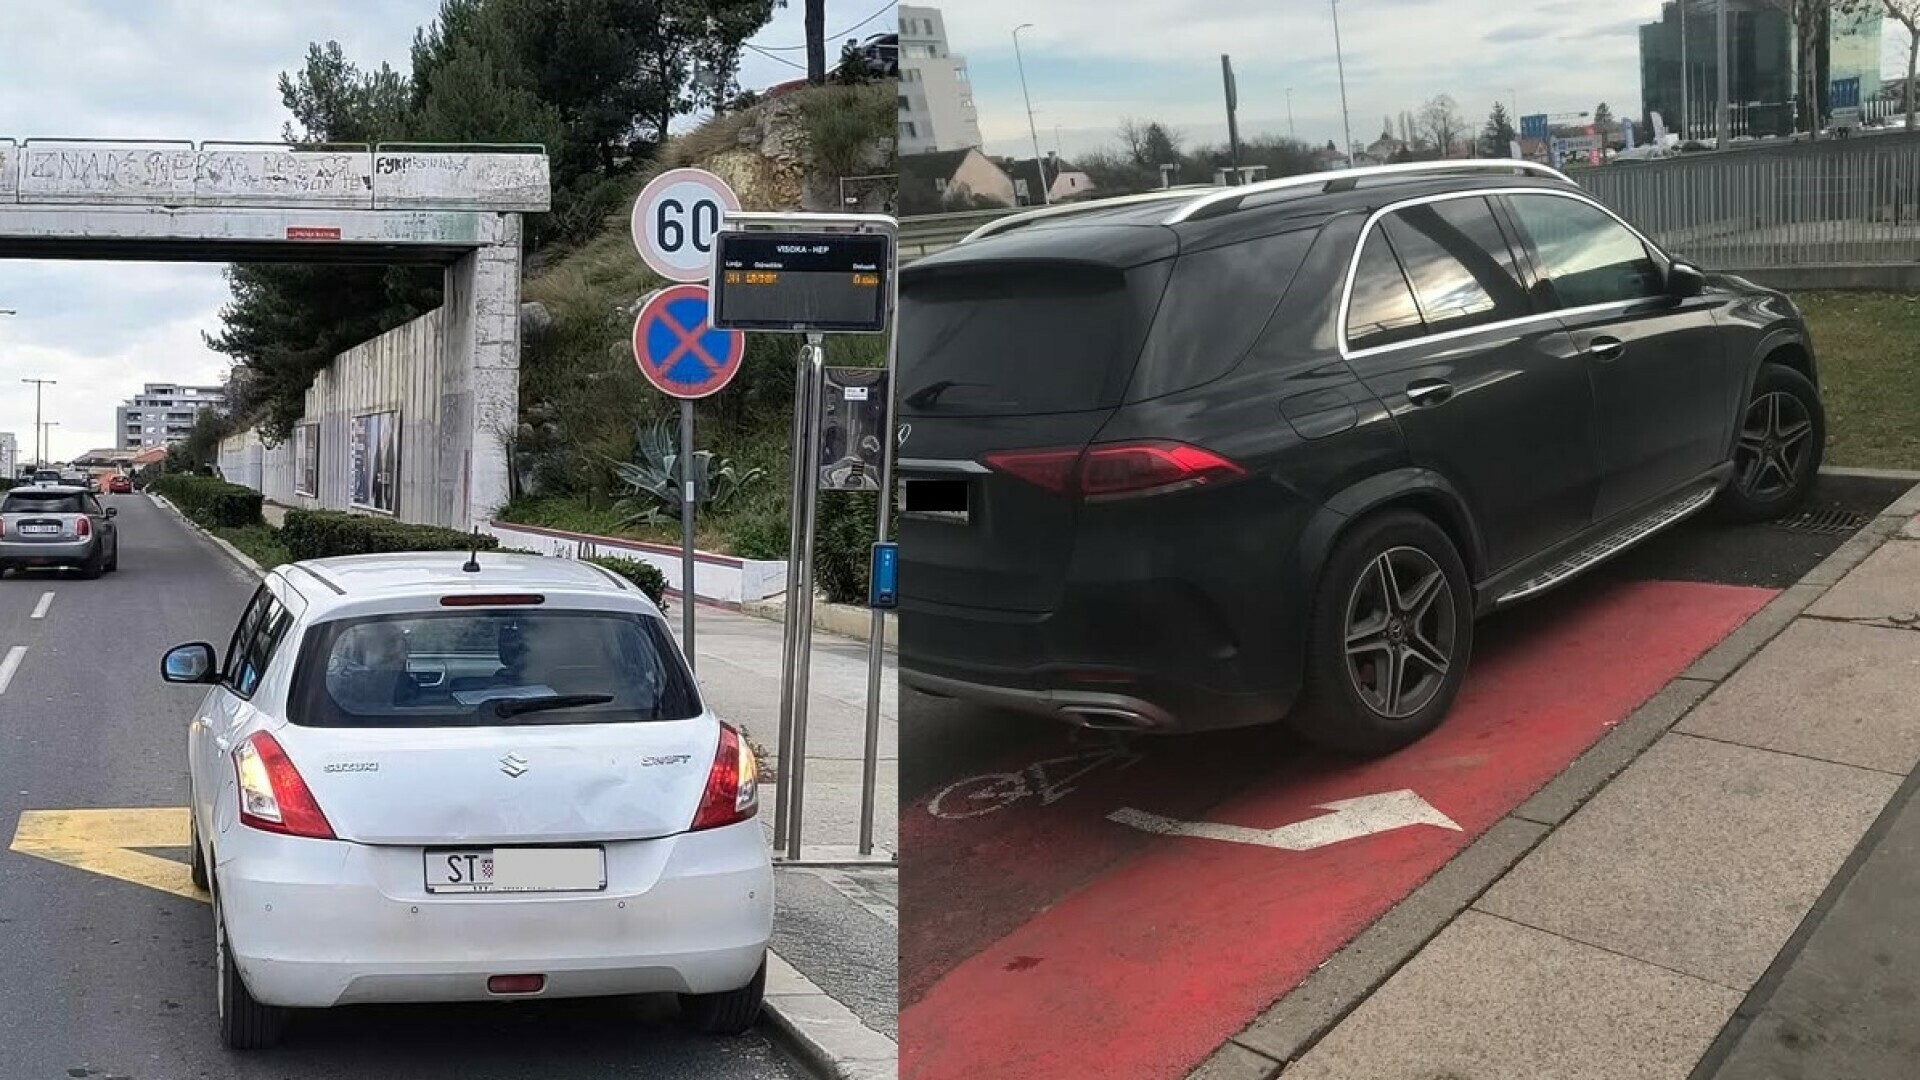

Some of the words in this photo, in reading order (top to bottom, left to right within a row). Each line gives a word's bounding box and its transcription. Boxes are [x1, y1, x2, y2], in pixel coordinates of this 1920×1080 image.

[657, 199, 718, 252] 60
[776, 245, 807, 253] VISOKA
[812, 245, 830, 254] HEP
[323, 761, 379, 773] SUZUKI
[641, 754, 692, 767] SWIFT
[447, 854, 479, 883] ST
